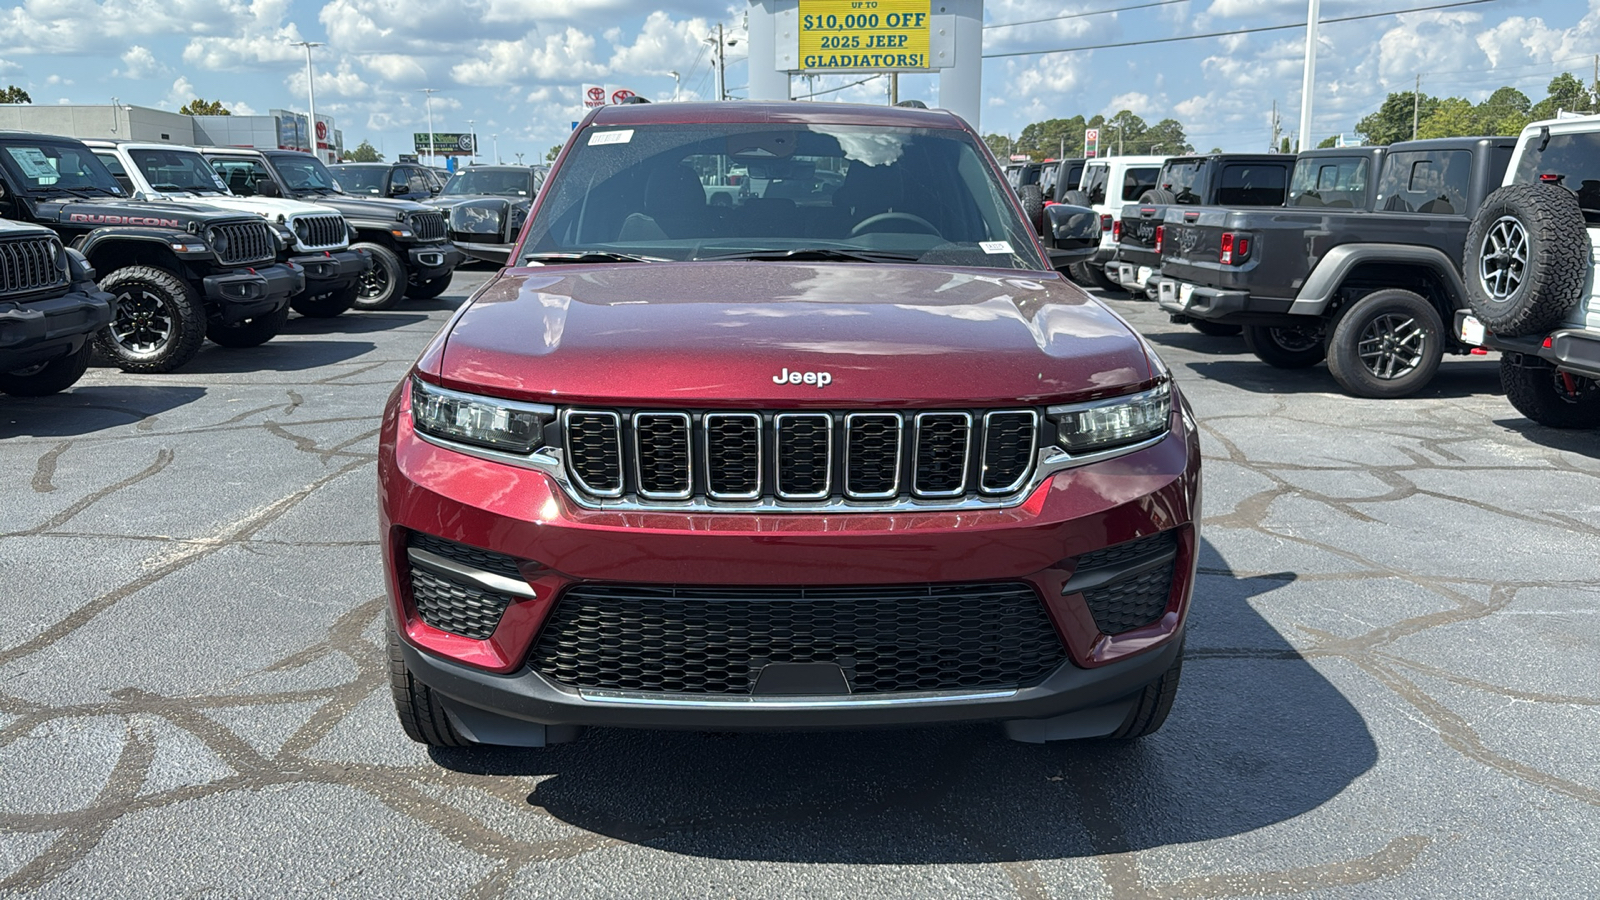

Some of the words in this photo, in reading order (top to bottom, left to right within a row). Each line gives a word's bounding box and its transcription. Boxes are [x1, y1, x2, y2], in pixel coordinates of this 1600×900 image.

[851, 1, 863, 9] UP
[866, 1, 878, 9] TO
[803, 14, 879, 32] $10,000
[886, 12, 926, 28] OFF
[821, 36, 860, 49] 2025
[866, 34, 908, 48] JEEP
[804, 53, 924, 68] GLADIATORS!
[70, 213, 178, 227] RUBICON
[772, 367, 832, 388] Jeep
